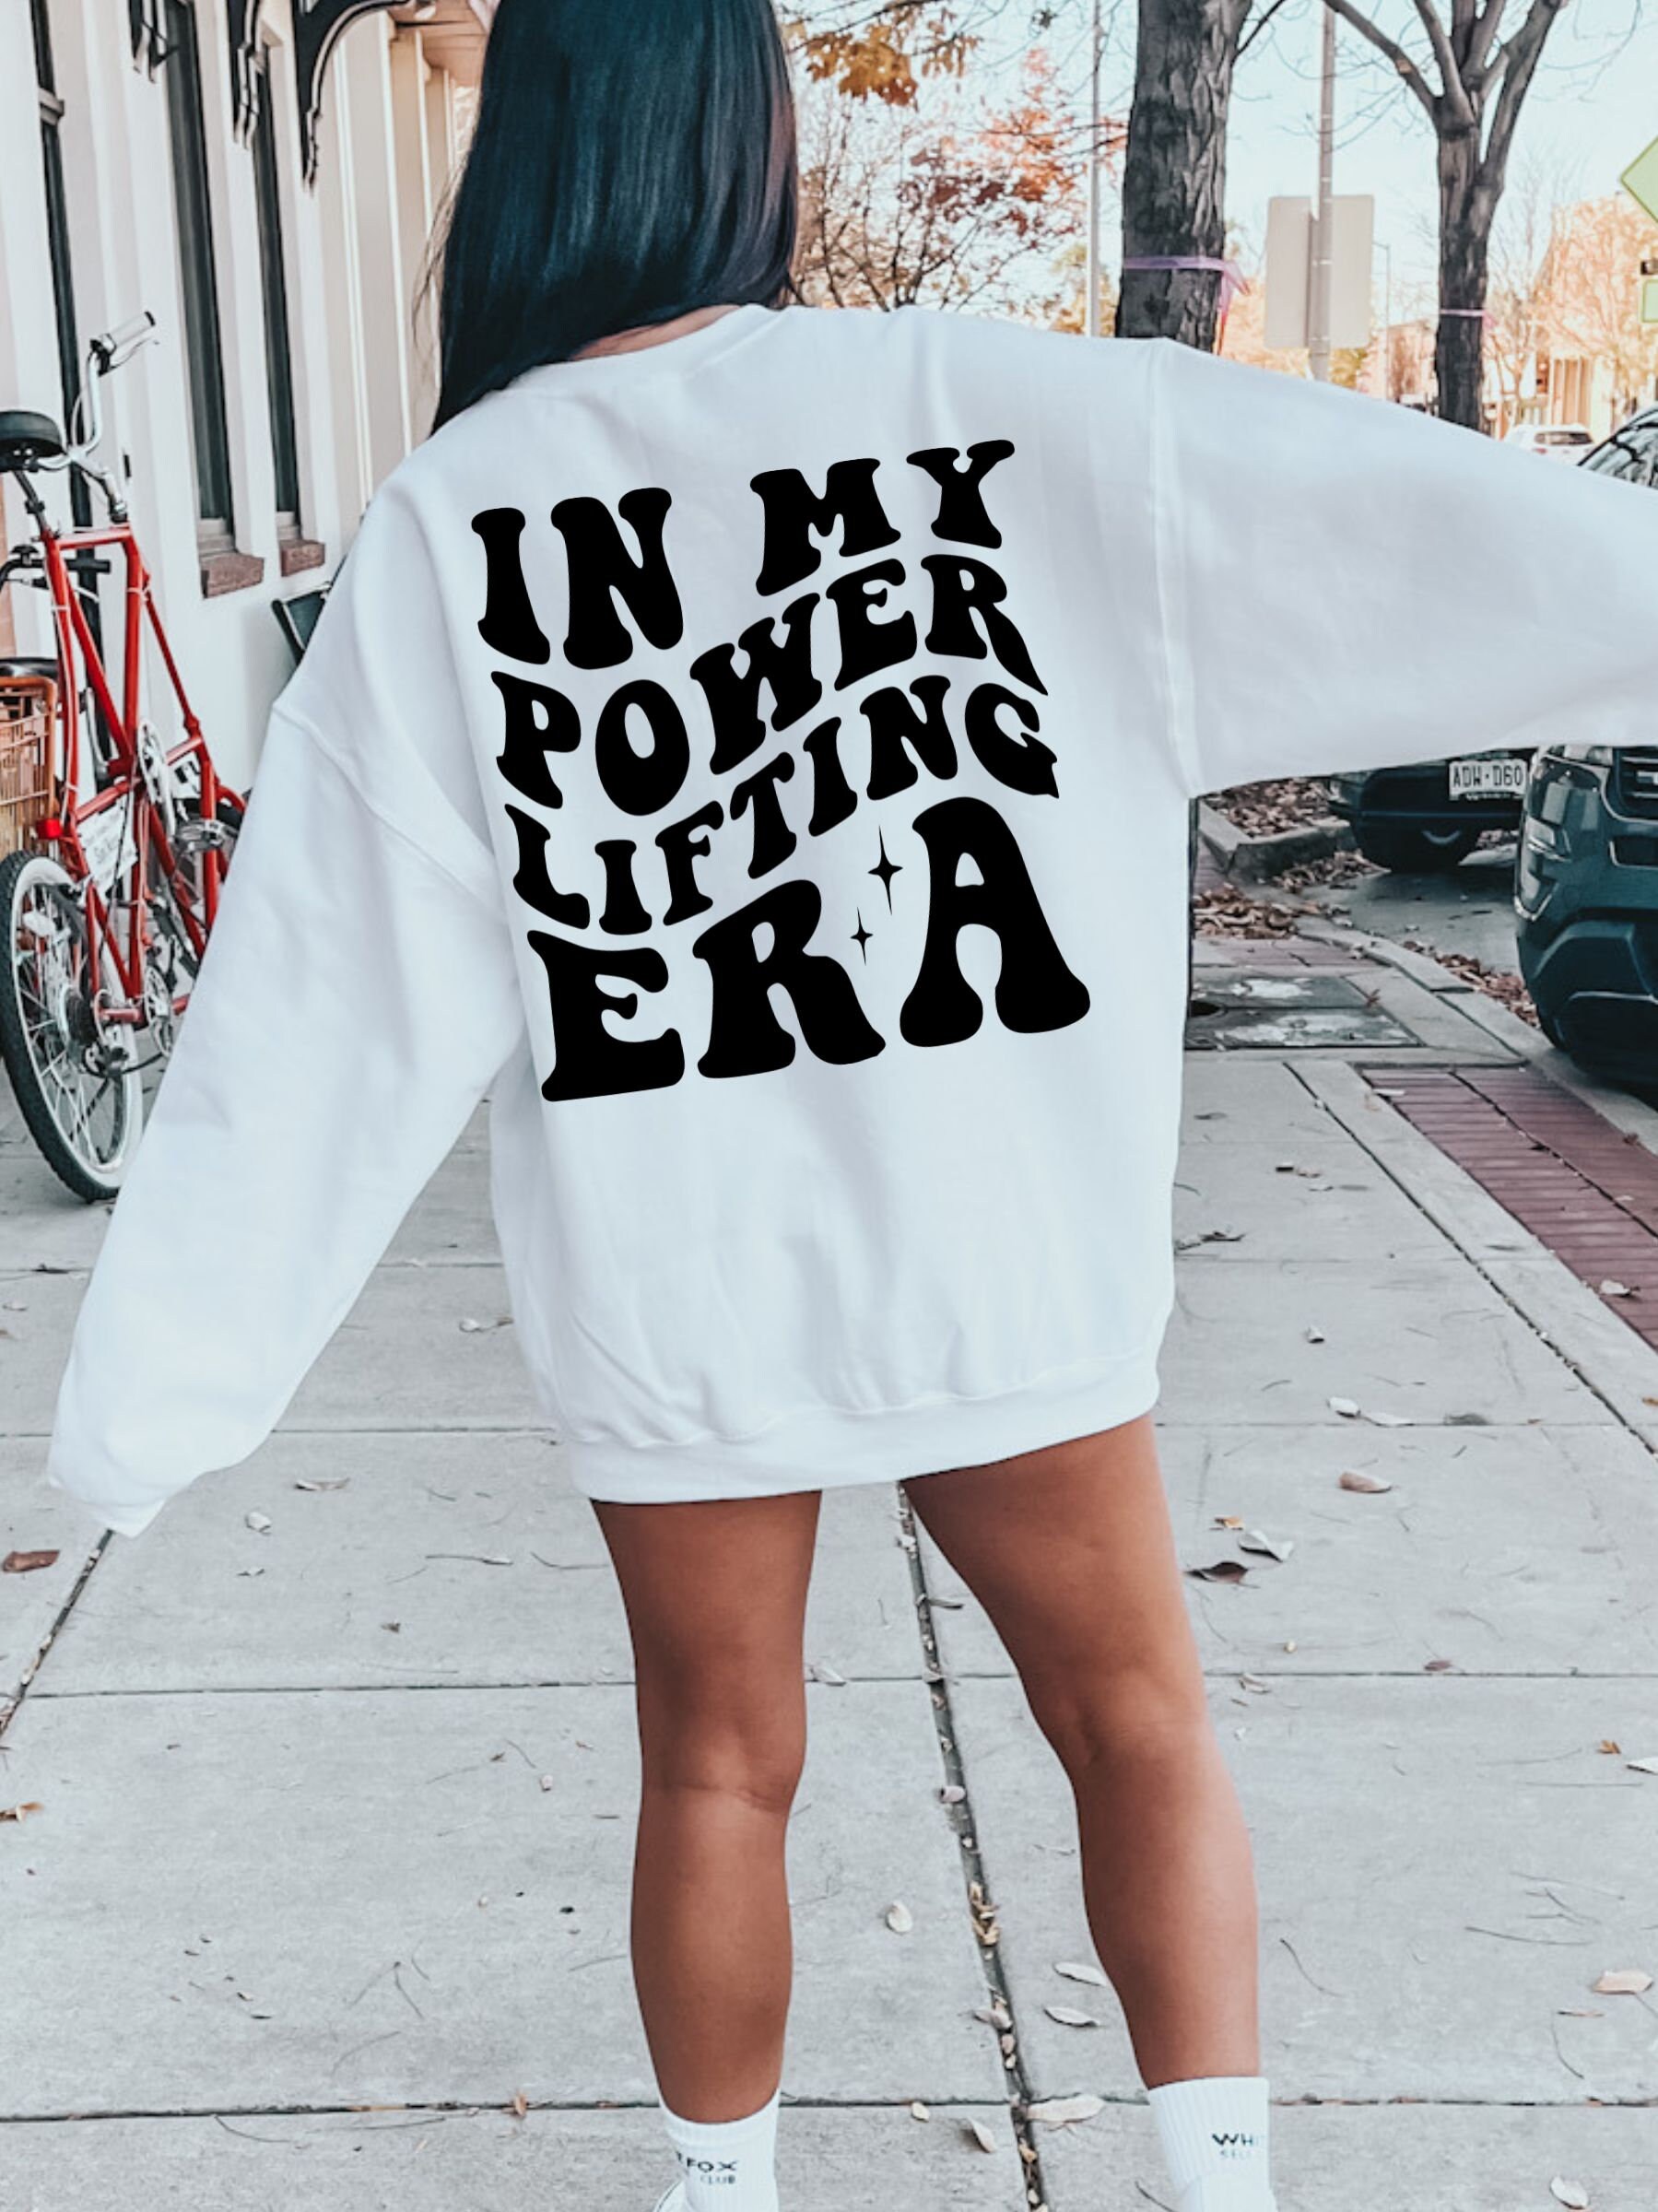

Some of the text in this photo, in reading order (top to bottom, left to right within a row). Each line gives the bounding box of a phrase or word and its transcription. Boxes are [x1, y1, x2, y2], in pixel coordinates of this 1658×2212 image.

[472, 440, 1015, 670] IN MY
[491, 554, 1048, 817] POWER
[505, 676, 1059, 935] LIFTING
[527, 797, 1090, 1101] ERA
